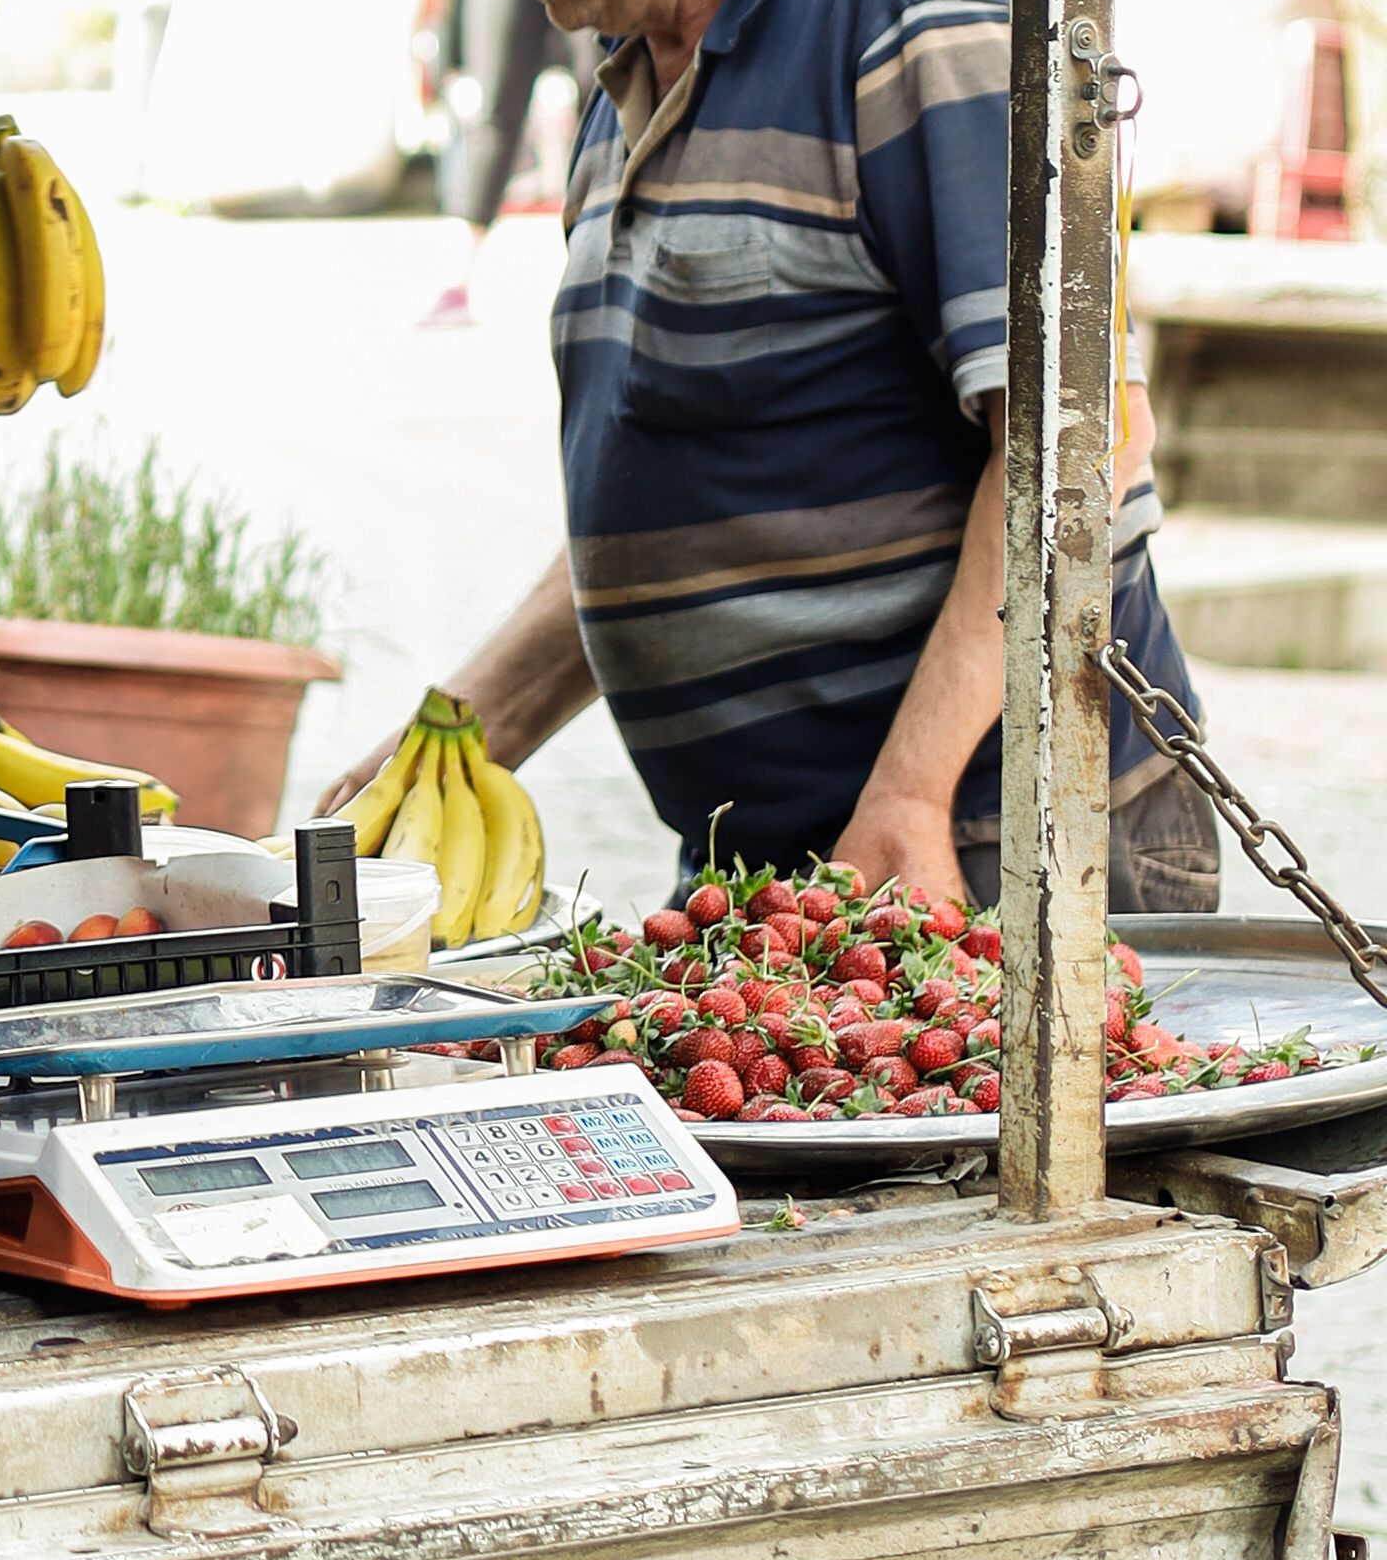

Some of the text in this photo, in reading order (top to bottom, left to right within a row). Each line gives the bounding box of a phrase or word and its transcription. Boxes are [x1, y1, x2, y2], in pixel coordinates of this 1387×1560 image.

[489, 1124, 507, 1139] 8
[521, 1121, 540, 1136] 9
[580, 1117, 605, 1128] M2
[611, 1113, 636, 1124] M1
[474, 1133, 653, 1164] 4 5 6 M4 M3
[488, 1154, 670, 1185] 1 2 3 M5 M6
[505, 1192, 523, 1206] 0
